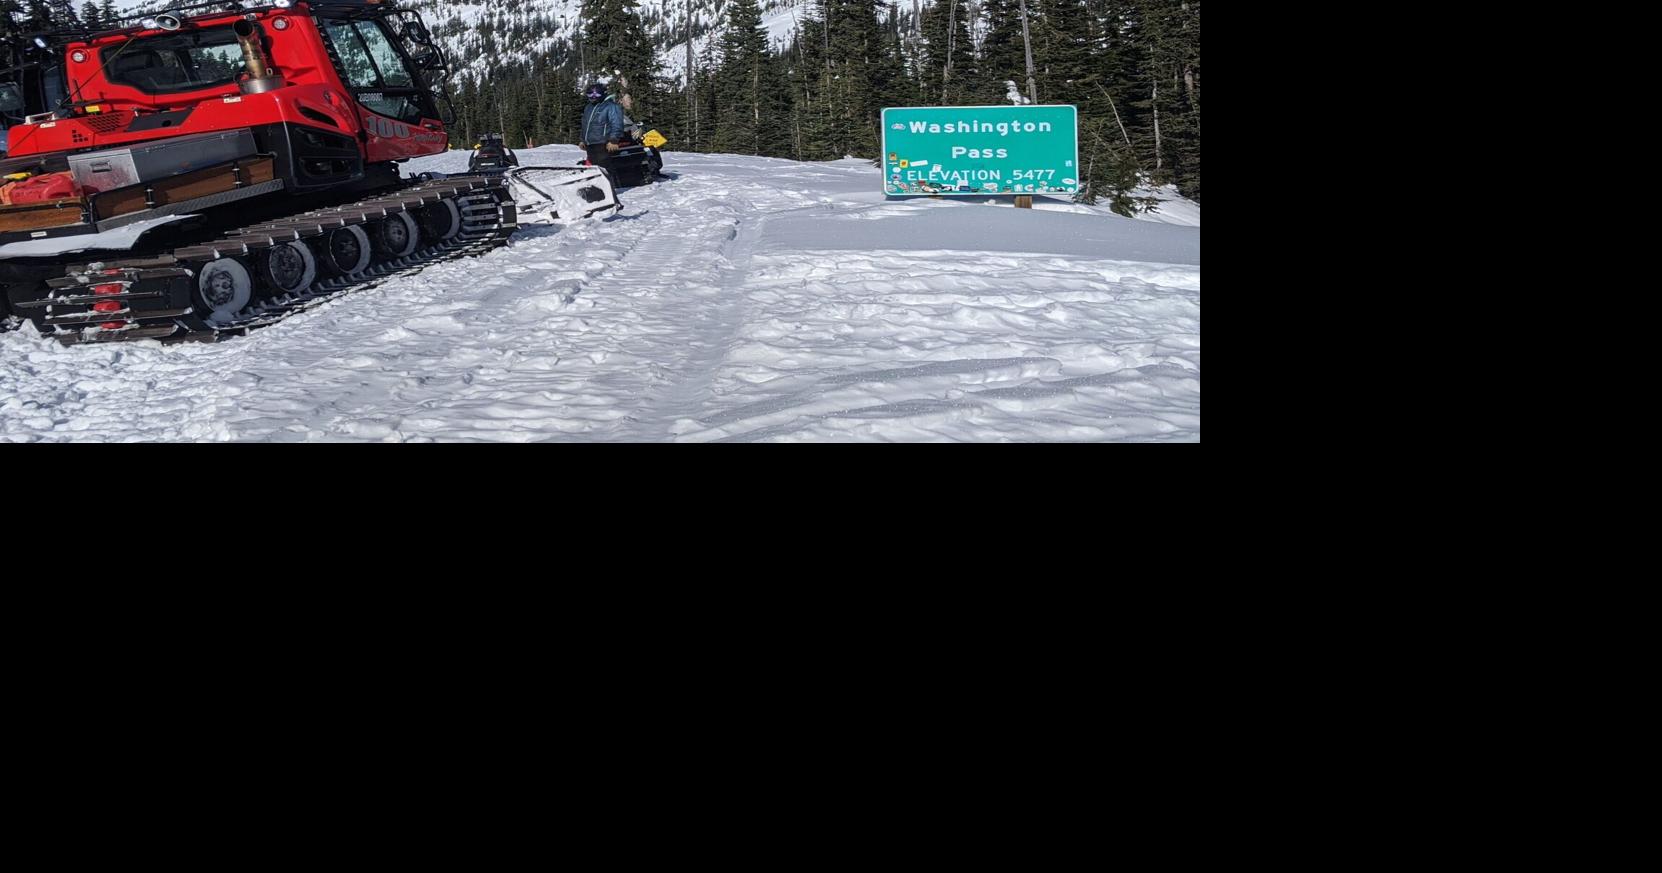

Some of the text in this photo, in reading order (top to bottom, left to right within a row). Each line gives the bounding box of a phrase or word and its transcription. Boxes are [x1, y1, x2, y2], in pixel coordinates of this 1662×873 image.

[367, 116, 410, 139] 100
[909, 119, 1052, 137] Washington
[951, 146, 1009, 159] Pass
[907, 169, 1056, 182] ELEVATION 5477
